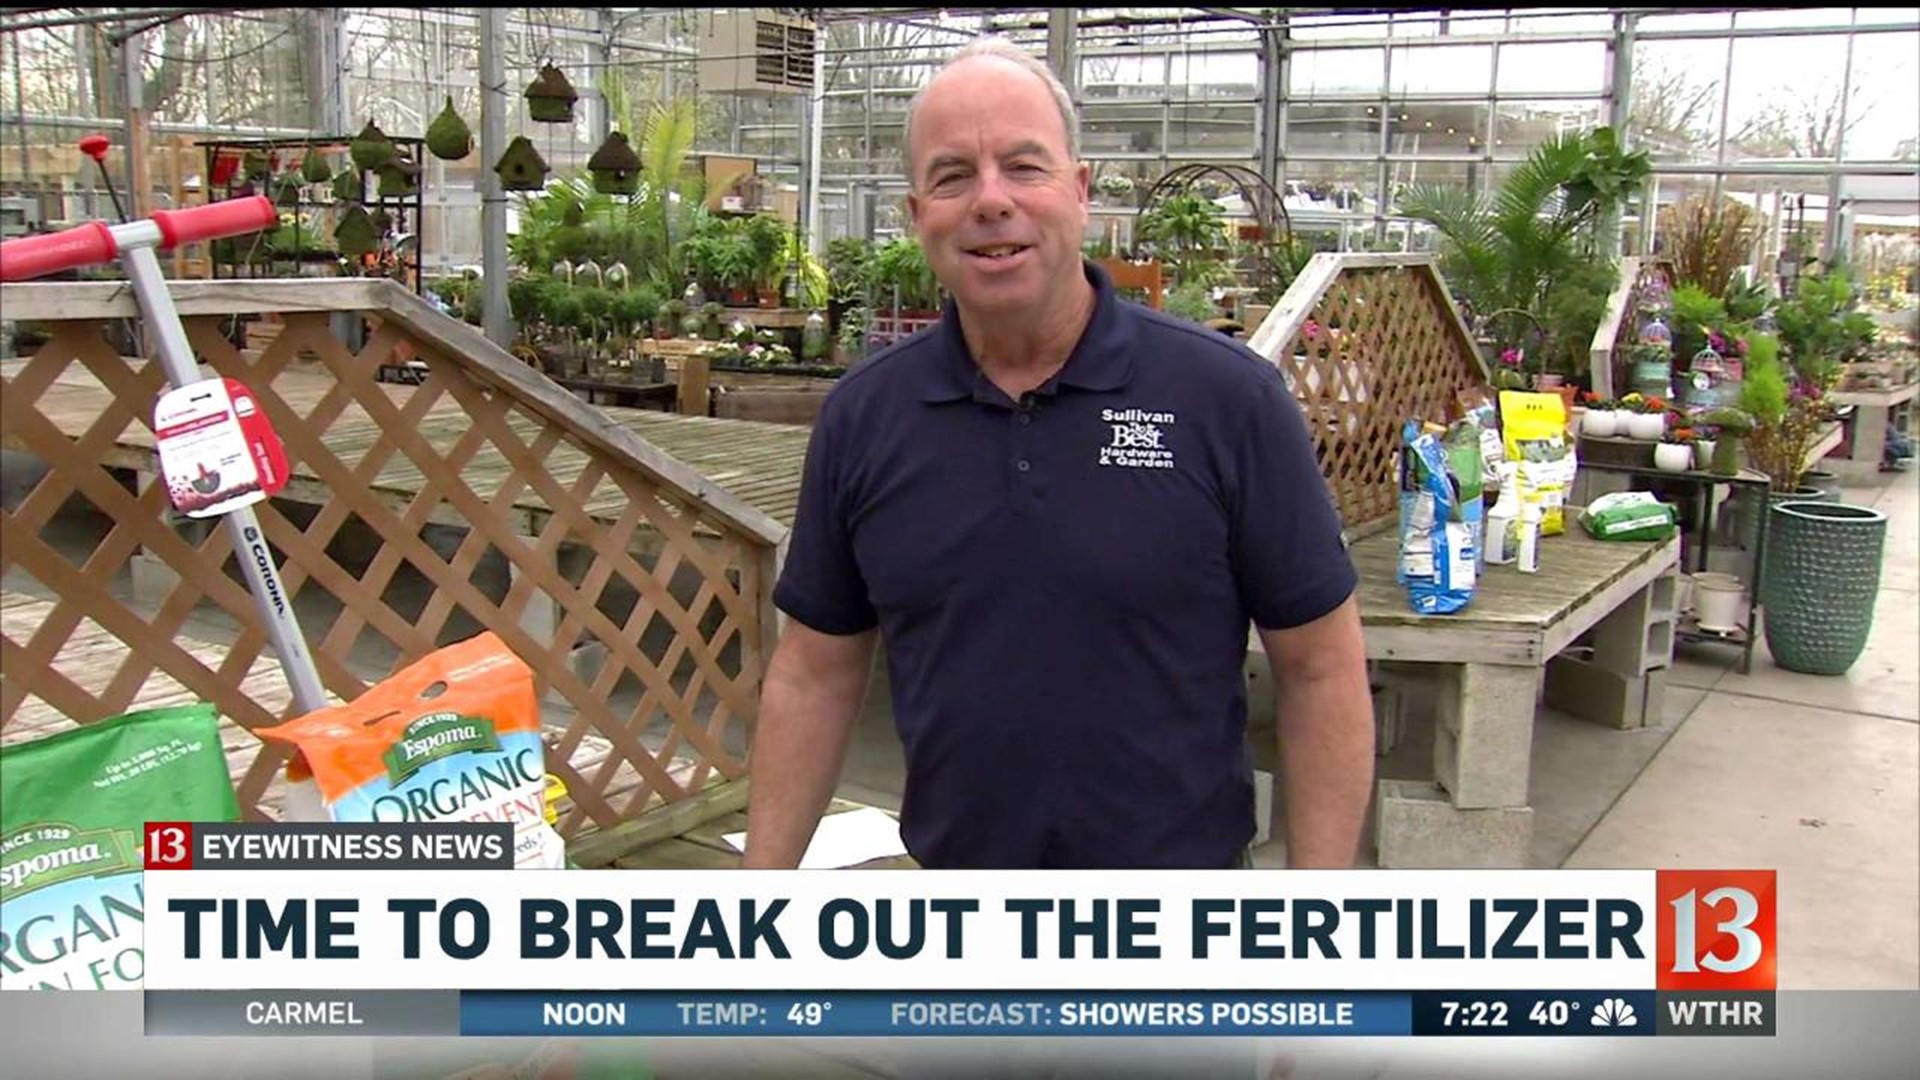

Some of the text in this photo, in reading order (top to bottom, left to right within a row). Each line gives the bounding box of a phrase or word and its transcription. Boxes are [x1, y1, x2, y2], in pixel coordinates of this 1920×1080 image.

[1101, 408, 1175, 423] Sullivan
[1111, 424, 1165, 449] Best
[1099, 455, 1174, 468] & Garden
[1100, 446, 1173, 458] Hardware
[372, 748, 543, 822] ORGANIC
[0, 831, 34, 854] INCE
[0, 843, 102, 889] spoma
